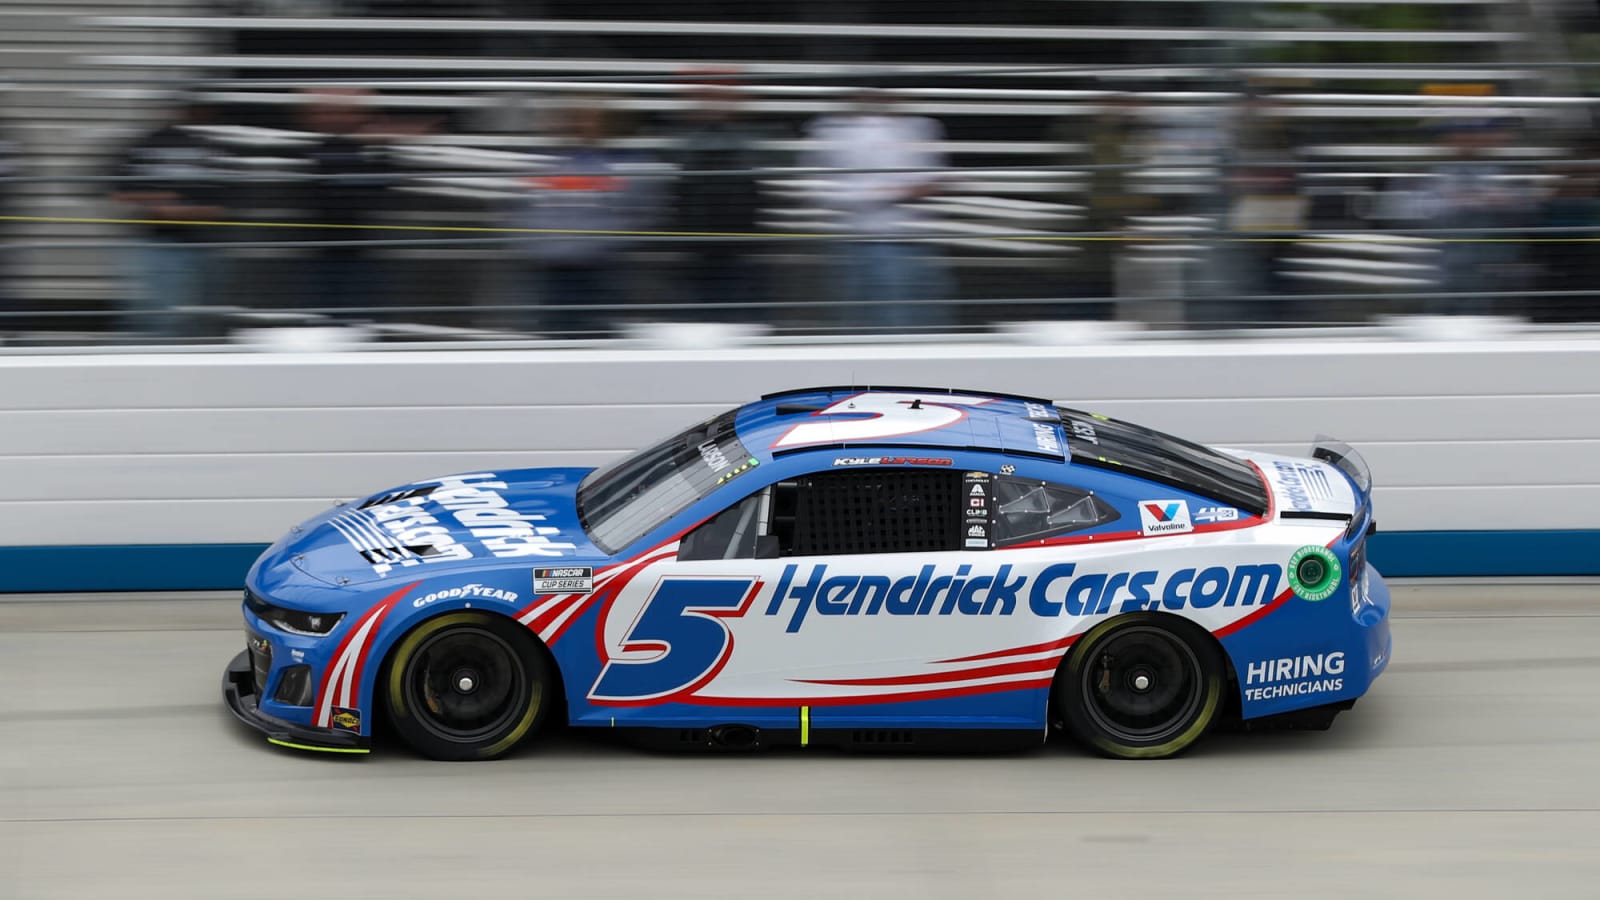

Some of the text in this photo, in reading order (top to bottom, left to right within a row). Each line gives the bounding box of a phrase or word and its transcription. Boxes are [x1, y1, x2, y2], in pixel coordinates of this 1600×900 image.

[770, 391, 998, 449] 5
[833, 457, 880, 466] KYLE
[410, 472, 577, 558] Hendrick
[1148, 522, 1185, 532] Valvoline
[552, 569, 584, 577] NASCAR
[558, 580, 585, 588] SERIES
[413, 583, 519, 608] GOODYEAR
[586, 575, 762, 703] 5
[1246, 651, 1345, 685] HIRING
[1245, 678, 1344, 701] TECHNICIANS
